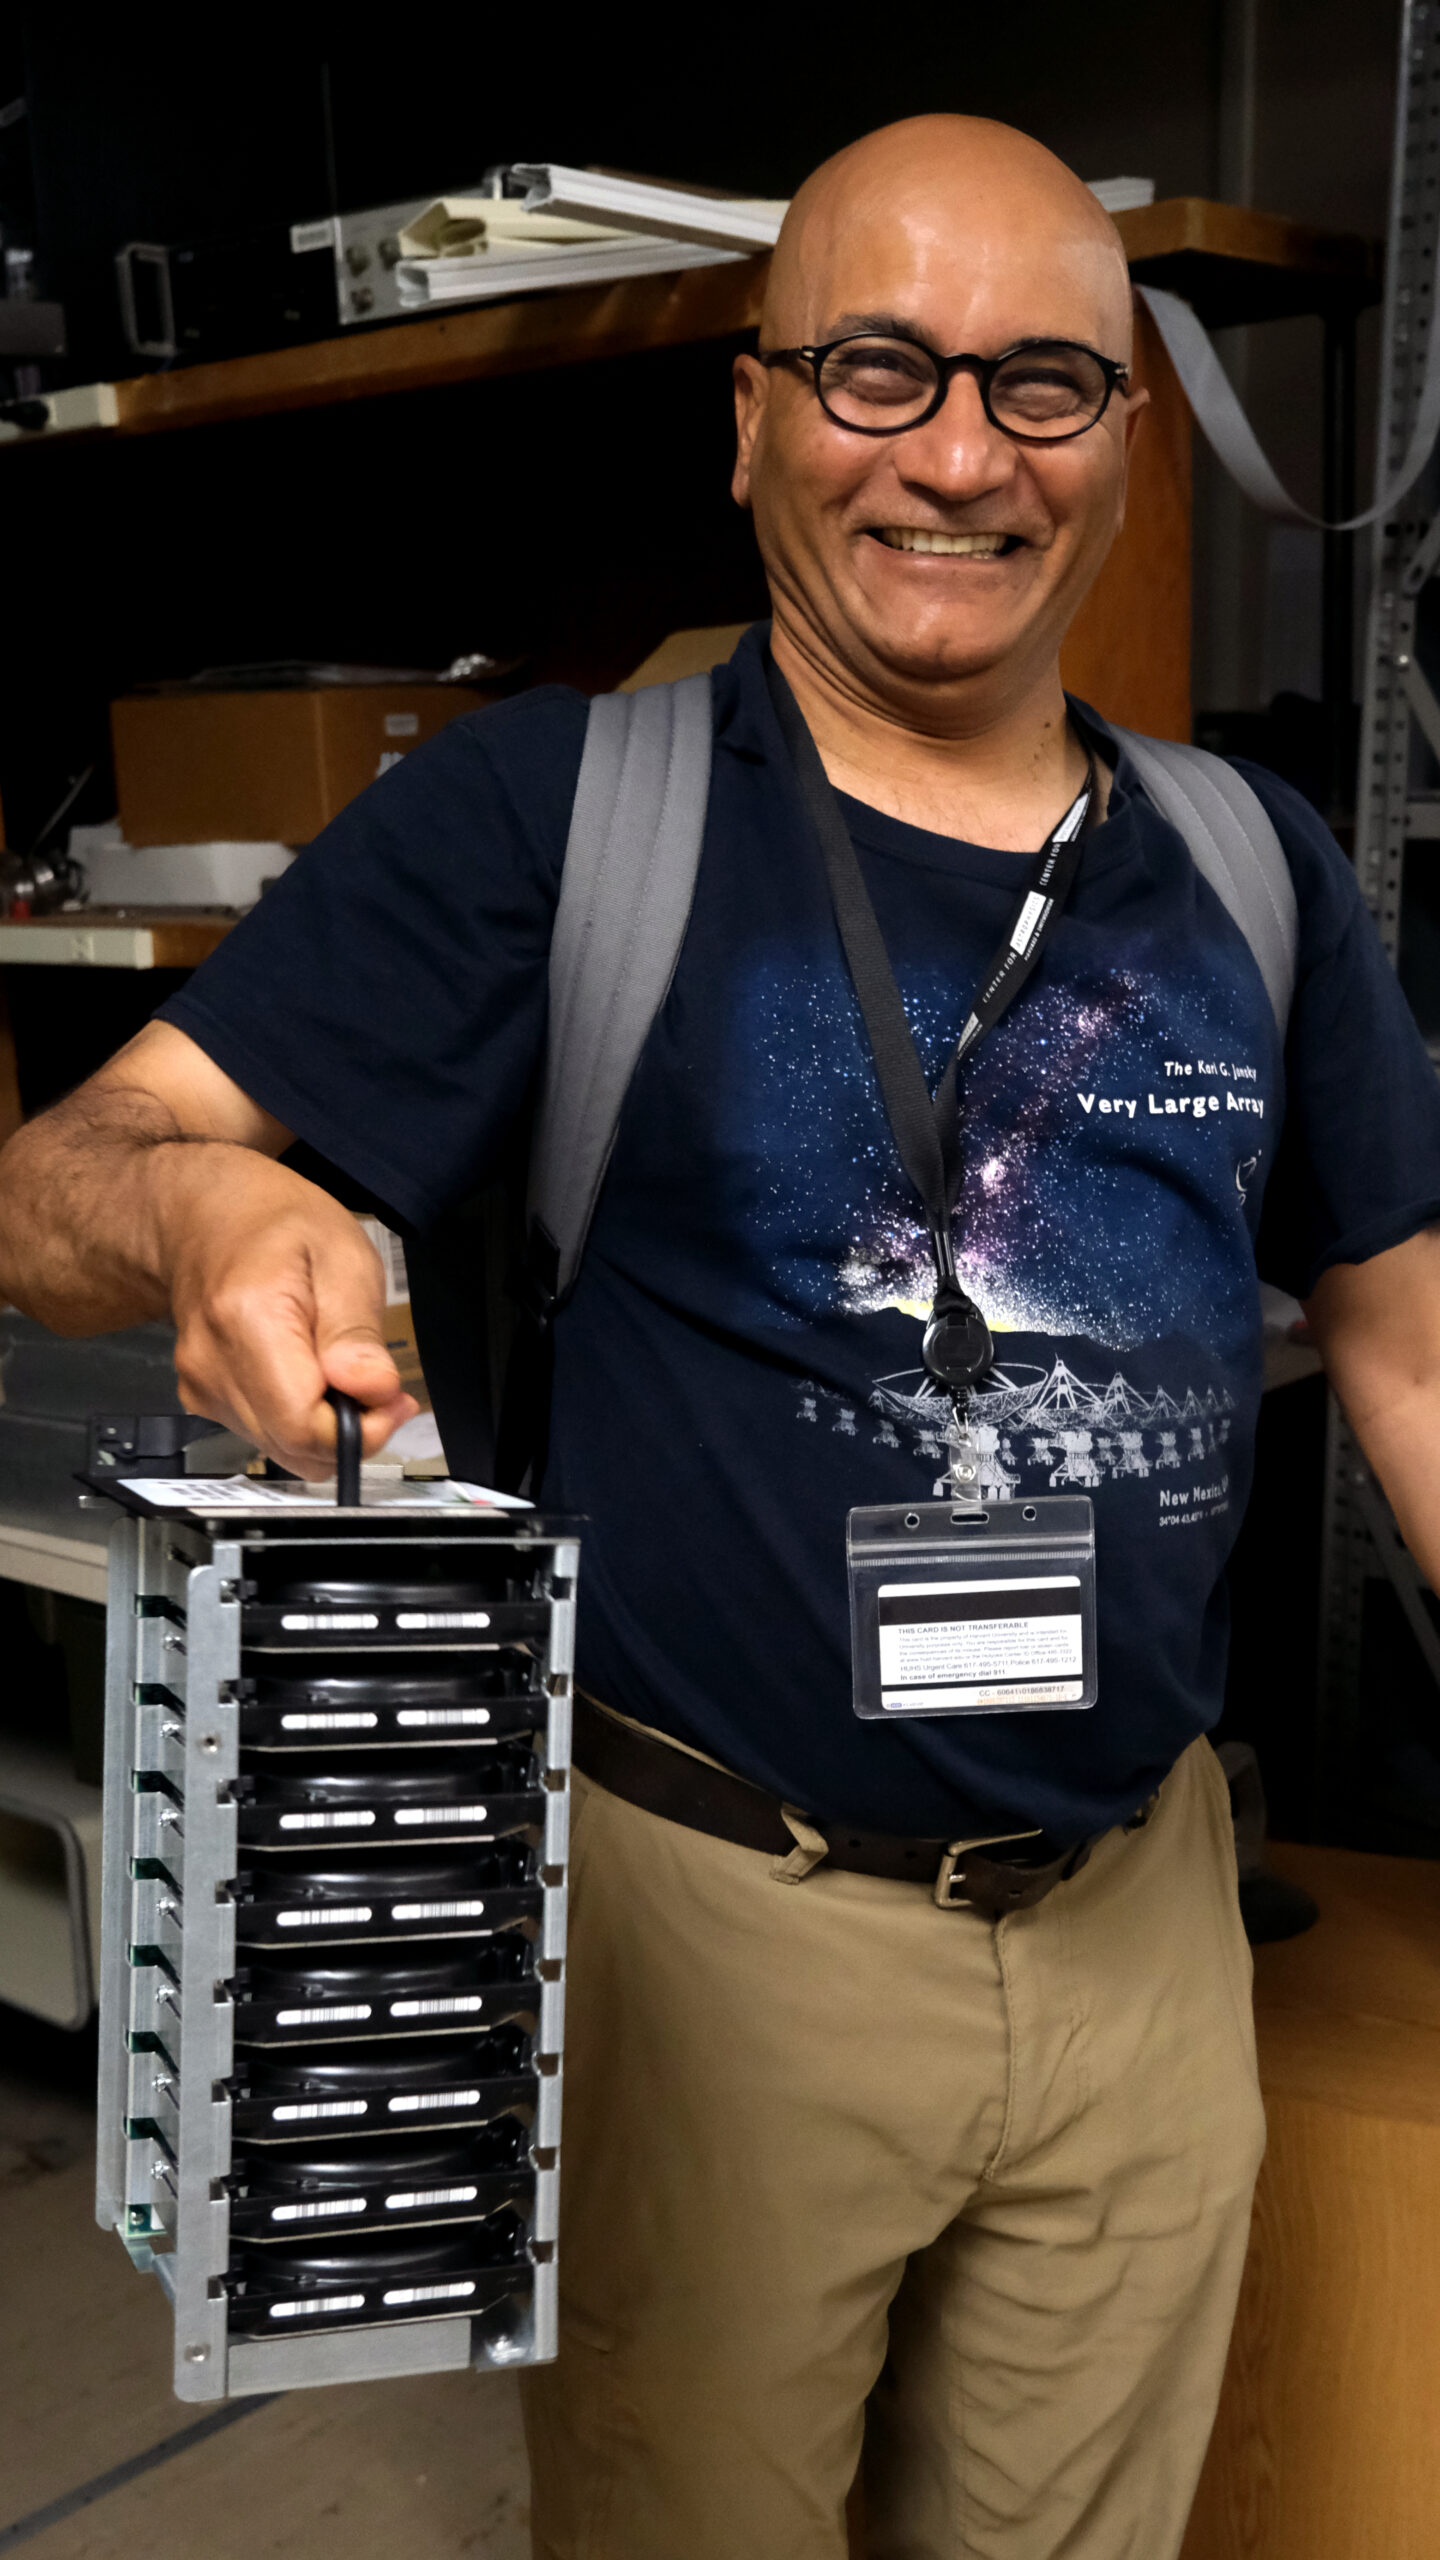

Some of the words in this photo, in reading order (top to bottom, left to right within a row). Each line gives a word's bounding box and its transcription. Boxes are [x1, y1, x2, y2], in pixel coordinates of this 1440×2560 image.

[1039, 859, 1056, 887] CENTER
[982, 970, 1006, 1004] CENTER
[1003, 951, 1017, 971] FOR
[1164, 1061, 1193, 1077] The
[1198, 1060, 1218, 1076] Karl
[1219, 1064, 1231, 1077] G.
[1232, 1063, 1257, 1083] Jansky
[1077, 1093, 1137, 1119] Very
[1148, 1093, 1220, 1118] Large
[1226, 1091, 1264, 1119] Array
[1160, 1489, 1189, 1507] New
[968, 1622, 1028, 1631] TRANSFERABLE
[937, 1671, 976, 1680] emergency
